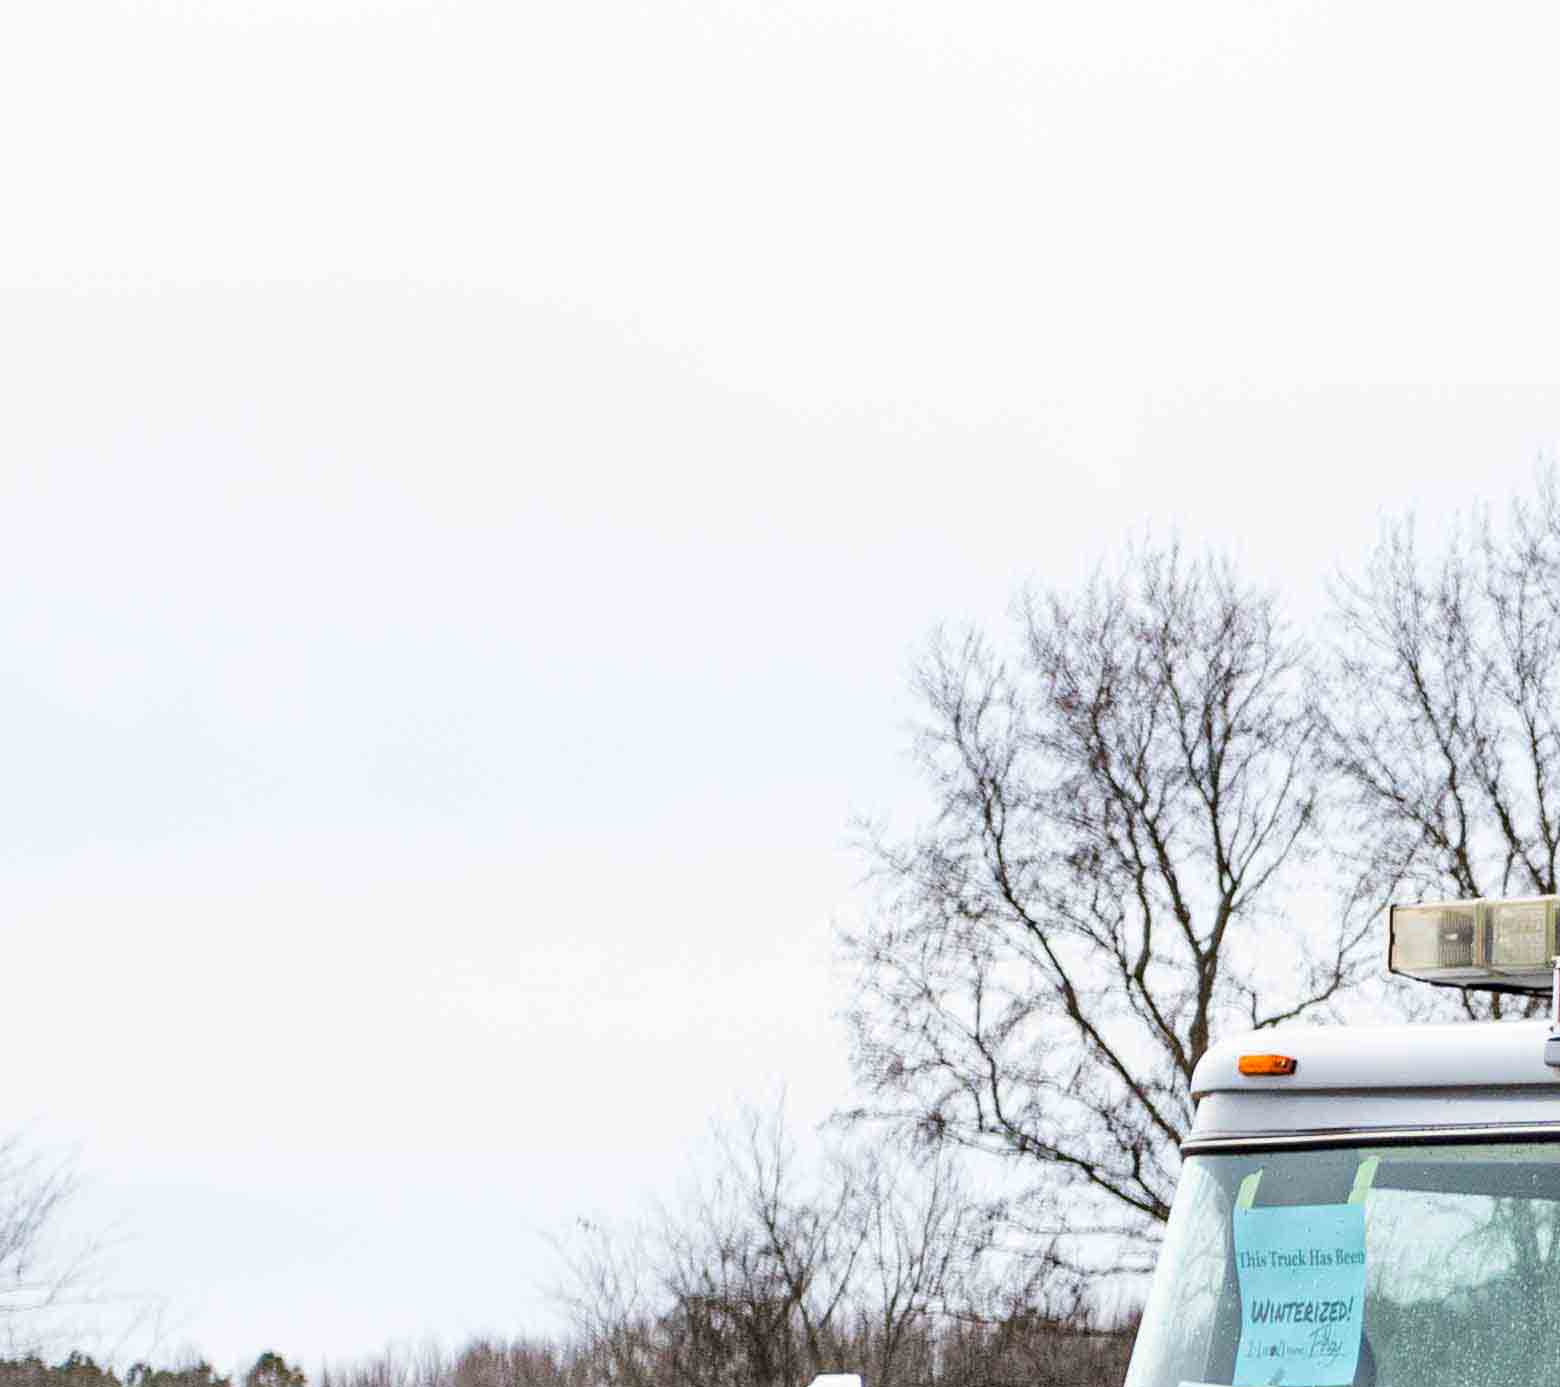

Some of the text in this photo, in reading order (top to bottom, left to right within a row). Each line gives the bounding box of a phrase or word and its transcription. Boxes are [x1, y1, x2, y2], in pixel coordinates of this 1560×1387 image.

[1270, 1249, 1306, 1267] Truck
[1310, 1249, 1333, 1266] Has
[1335, 1248, 1365, 1265] Been
[1250, 1295, 1354, 1323] WINTERIZED!
